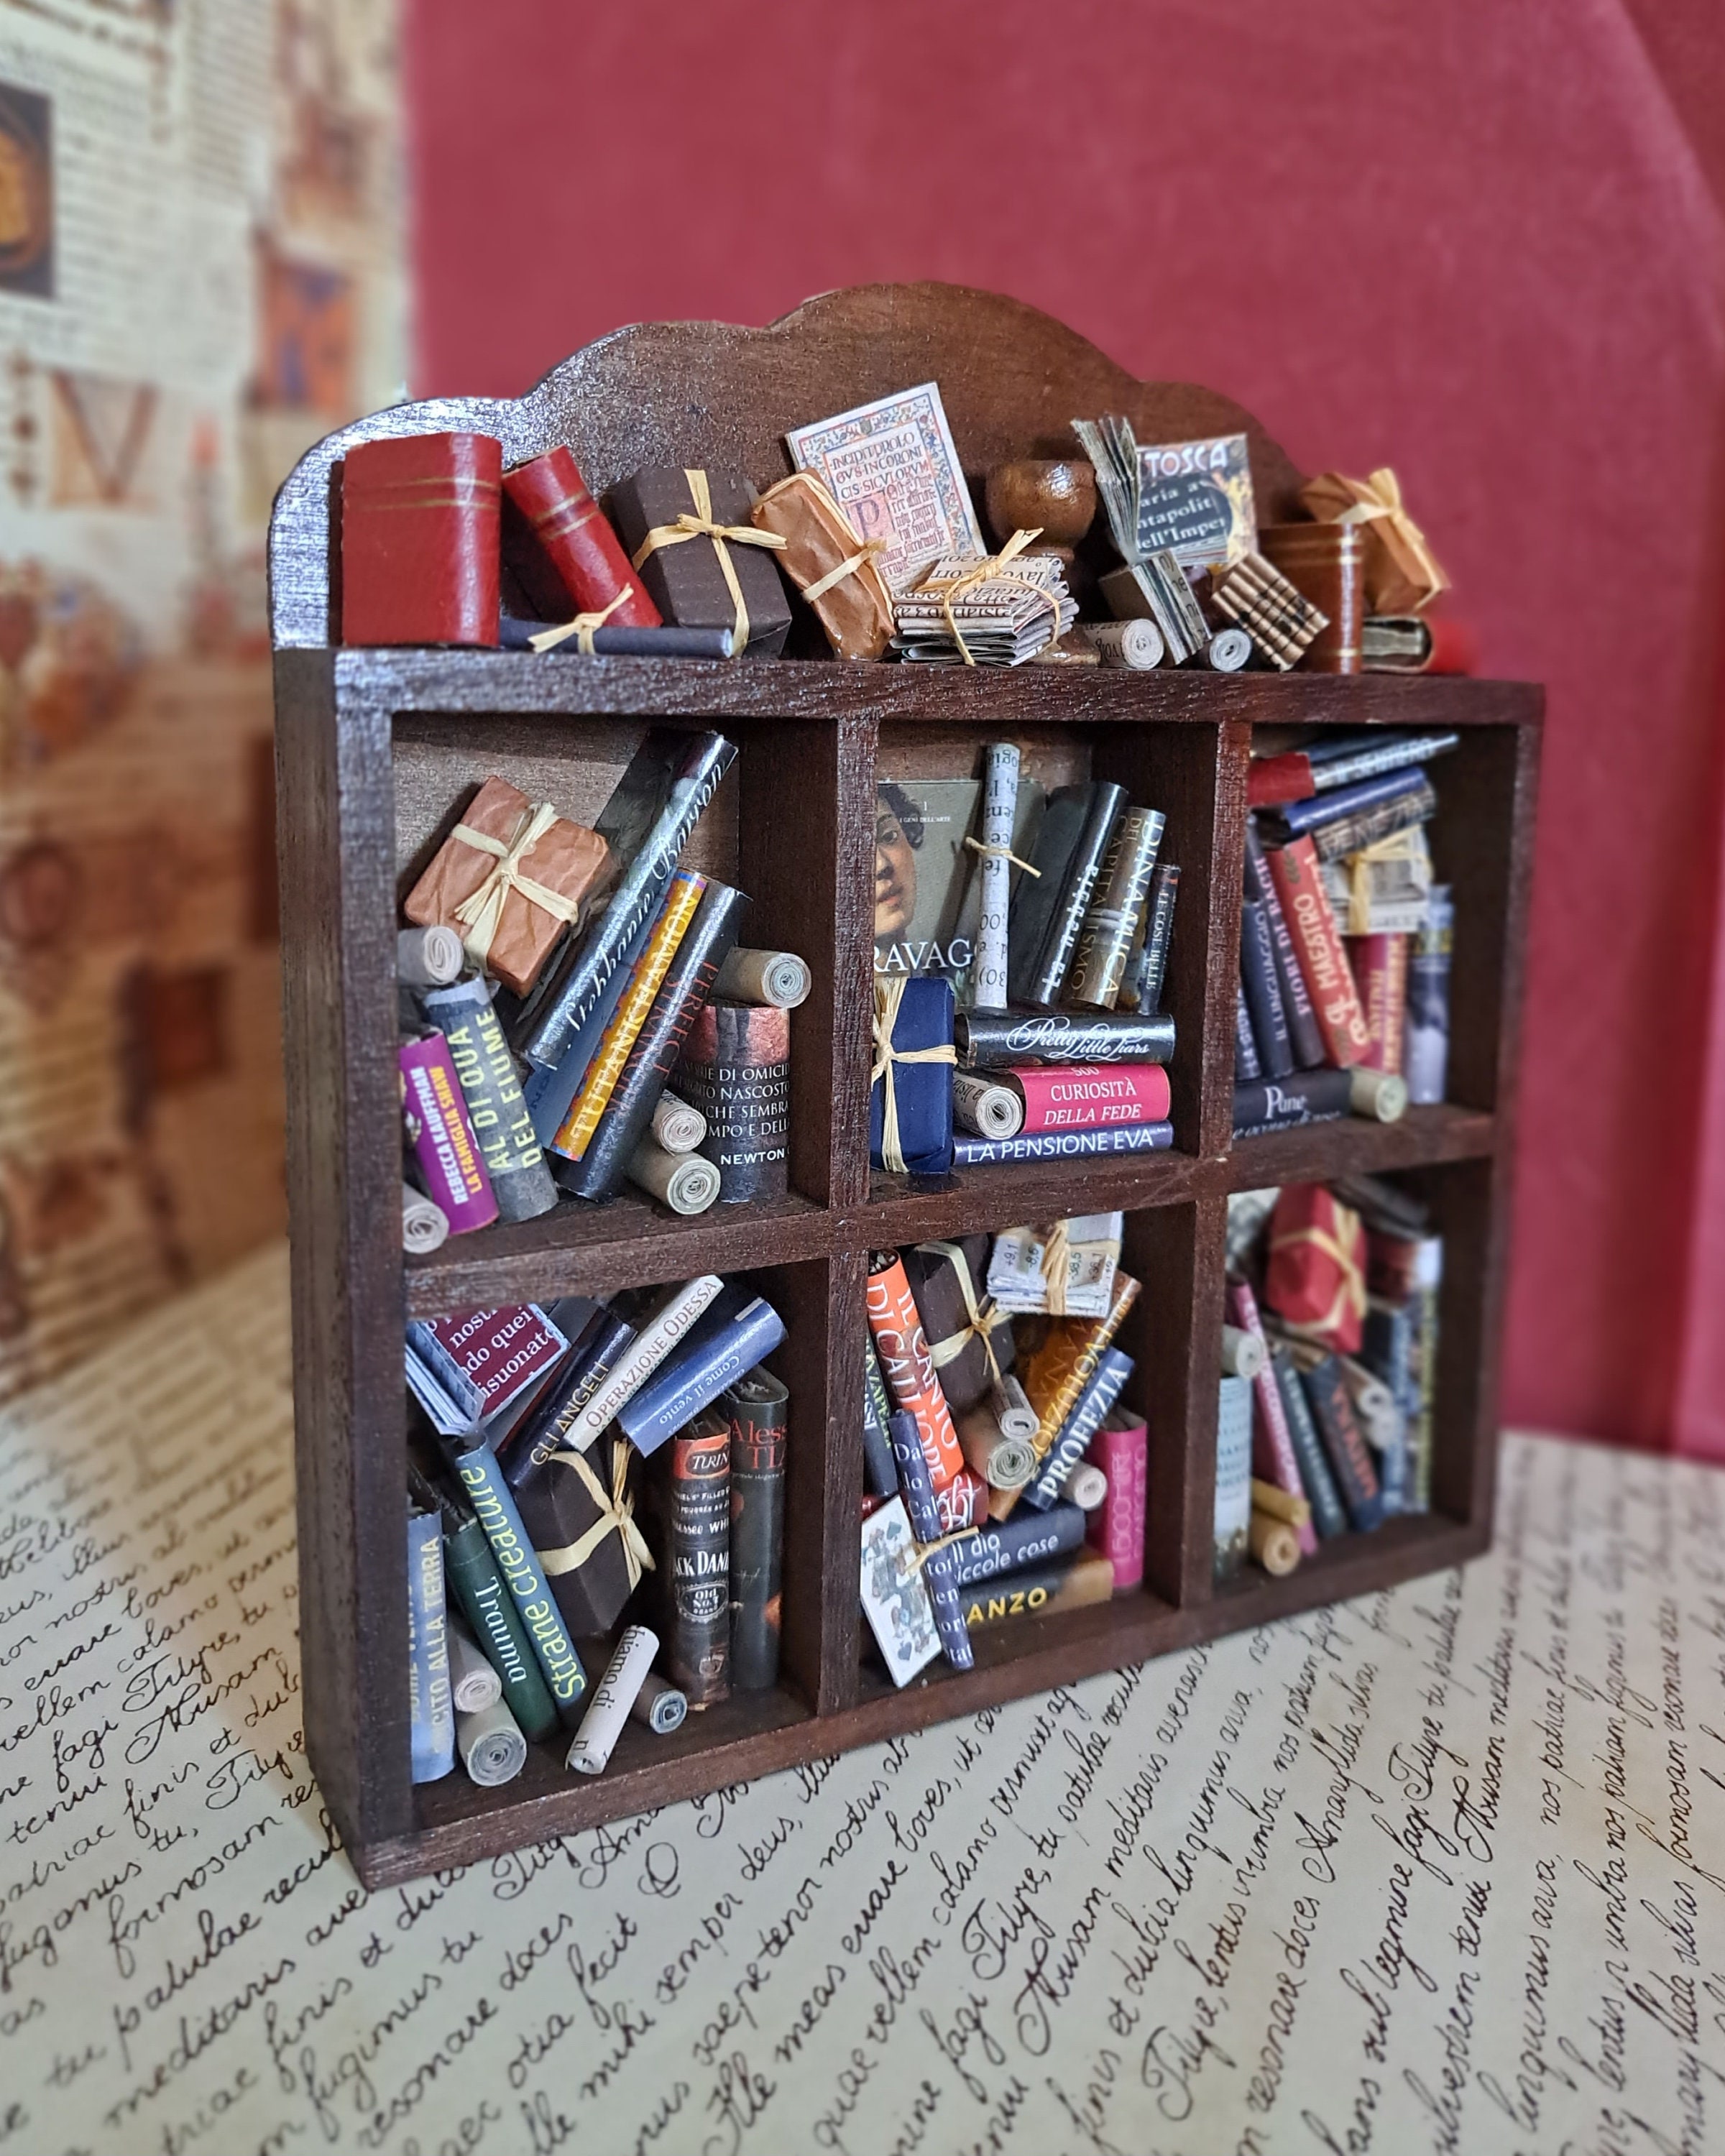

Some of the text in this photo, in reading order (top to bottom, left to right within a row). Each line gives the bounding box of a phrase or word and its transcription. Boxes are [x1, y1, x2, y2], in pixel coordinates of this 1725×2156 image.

[1144, 442, 1228, 478] TOSCA
[1137, 497, 1213, 530] ntapolit
[1140, 486, 1179, 509] aria
[1071, 814, 1129, 991] CAPITALISMO
[1100, 820, 1164, 993] DINAMICA
[873, 938, 977, 973] RAVAG
[1293, 892, 1340, 991] MAESTRO
[1006, 1016, 1150, 1062] Pretty Little Liars
[474, 1007, 543, 1169] DEL FIUME
[719, 1068, 736, 1082] DI
[1050, 1077, 1138, 1102] CURIOSITÀ
[446, 1026, 513, 1169] AL DI QUA
[706, 1105, 735, 1119] CHE
[1043, 1103, 1143, 1126] DELLA FEDE
[410, 1066, 470, 1205] REBECCA KAUFFMAN
[428, 1066, 484, 1194] LA FAMIGLIA SHAW
[708, 1124, 742, 1138] MPO
[748, 1123, 756, 1137] E
[967, 1128, 1154, 1164] LA PENSIONE EVA
[720, 1148, 785, 1166] NEWTON
[866, 1282, 896, 1321] DI
[490, 1305, 533, 1349] quei
[584, 1337, 668, 1428] OPERAZIONE
[663, 1279, 717, 1337] ODESSA
[704, 1354, 740, 1387] Come
[529, 1360, 610, 1465] GLI ANGELI
[658, 1394, 693, 1425] vento
[692, 1383, 707, 1398] il
[1037, 1365, 1129, 1500] PROFEZIA
[956, 1534, 1059, 1585] iccole cose
[970, 1533, 1000, 1559] dio
[420, 1535, 443, 1613] TERRA
[459, 1465, 587, 1700] Strane creature
[472, 1575, 528, 1684] Trauma
[602, 1626, 646, 1685] hiamo
